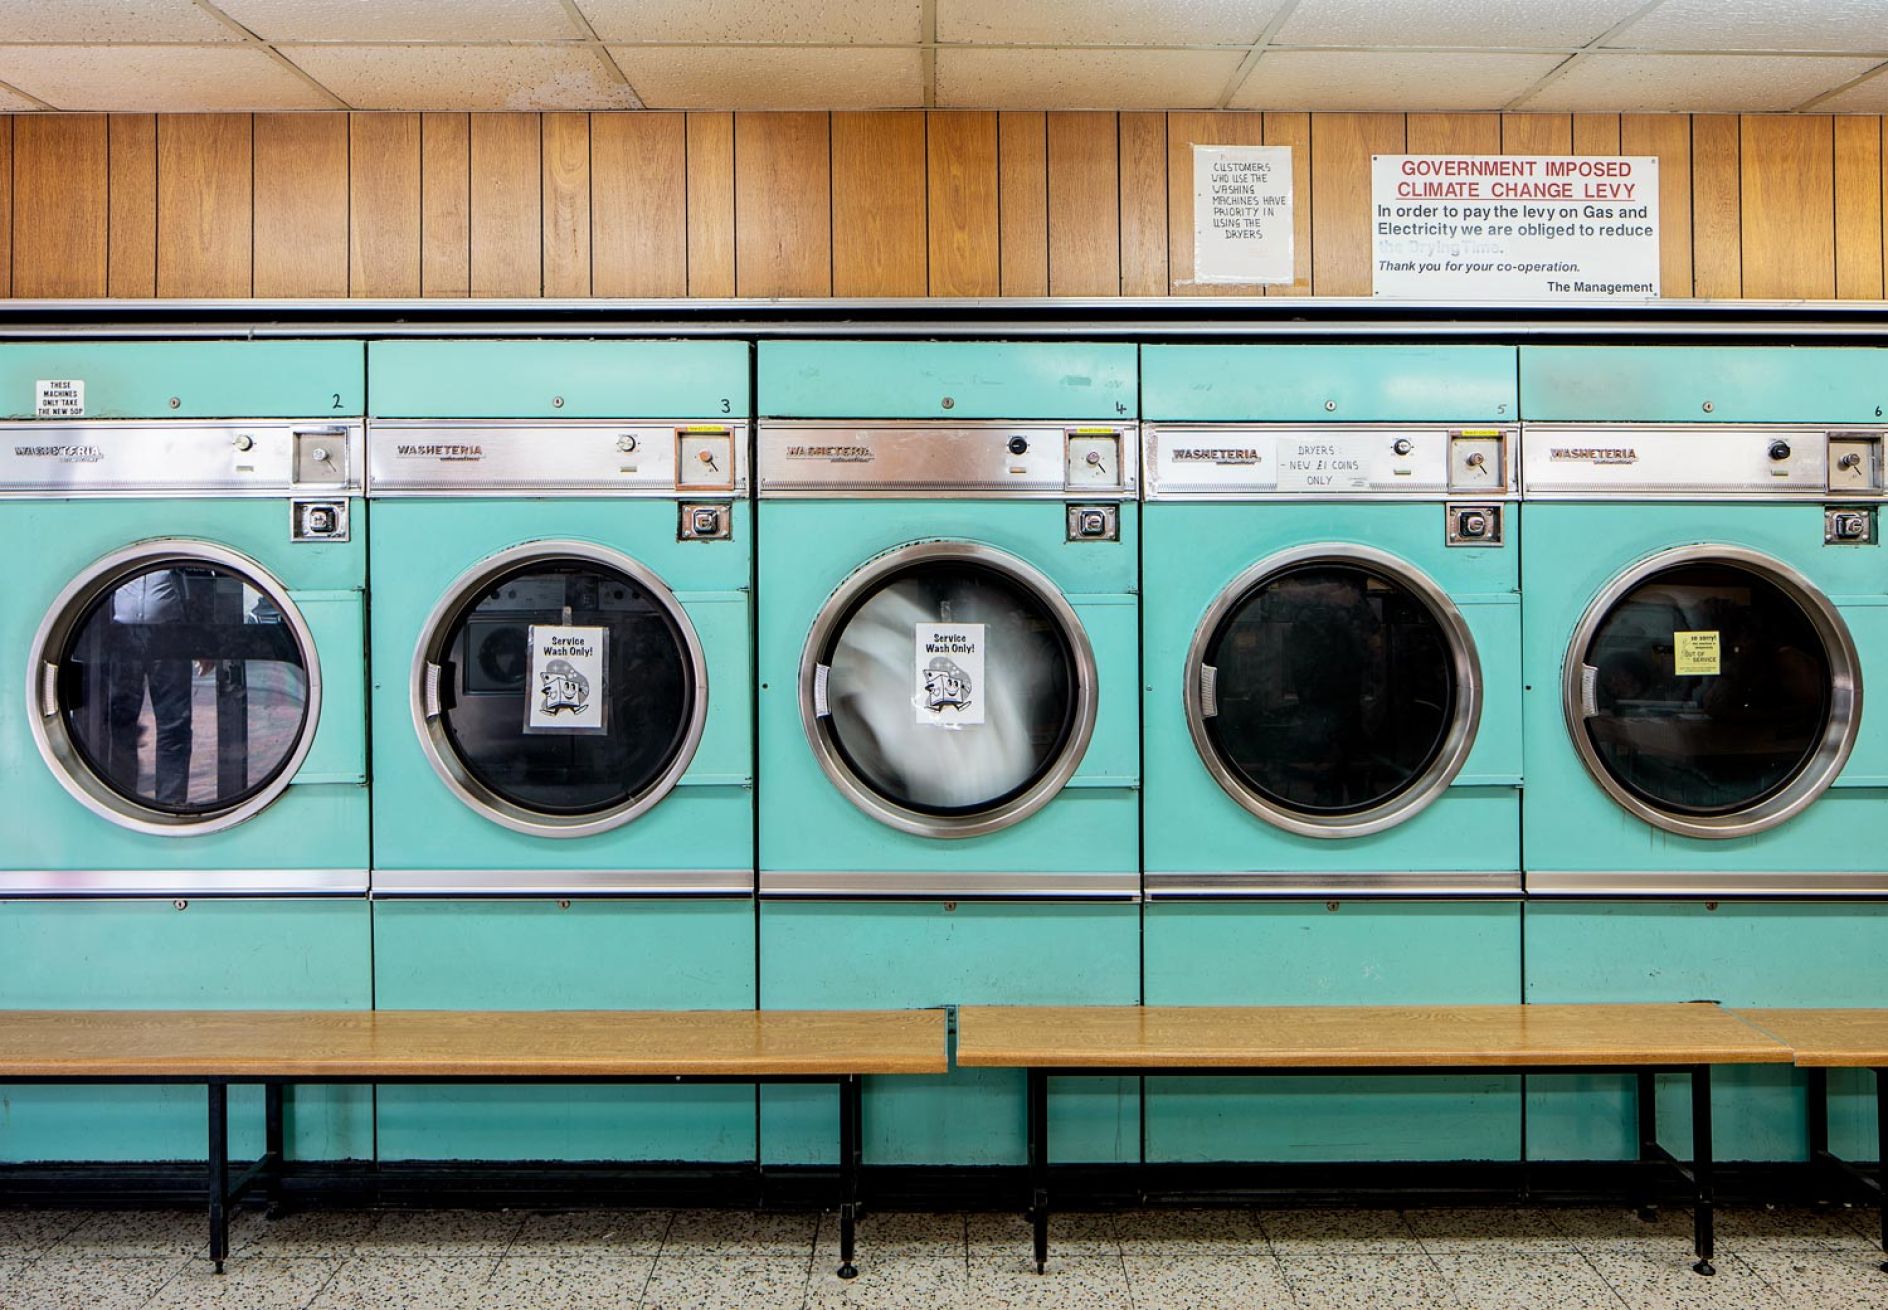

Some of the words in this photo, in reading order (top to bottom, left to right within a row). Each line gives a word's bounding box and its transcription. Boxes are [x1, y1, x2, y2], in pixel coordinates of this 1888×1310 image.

[1213, 162, 1272, 172] CUSTOMERS
[1401, 160, 1537, 177] GOVERNMENT
[1545, 161, 1631, 177] IMPOSED
[1211, 173, 1229, 183] WHO
[1232, 173, 1248, 183] USE
[1250, 173, 1268, 183] THE
[1212, 184, 1255, 195] WASHING
[1397, 181, 1480, 198] CLIMATE
[1491, 182, 1573, 198] CHANGE
[1584, 183, 1636, 199] LEVY
[1212, 196, 1260, 206] MACHINES
[1263, 196, 1286, 206] HAVE
[1213, 207, 1259, 217] PRIORITY
[1263, 207, 1275, 217] IN
[1377, 204, 1391, 218] In
[1396, 204, 1438, 219] order
[1443, 206, 1458, 219] to
[1463, 208, 1490, 221] pay
[1494, 205, 1519, 219] the
[1523, 205, 1556, 222] levy
[1559, 208, 1578, 219] on
[1583, 206, 1613, 219] Gas
[1619, 206, 1648, 219] and
[1213, 218, 1241, 228] USING
[1243, 218, 1261, 228] THE
[1225, 229, 1264, 239] DRYERS
[1378, 222, 1457, 238] Electricity
[1460, 225, 1482, 236] we
[1487, 225, 1513, 236] are
[1518, 223, 1576, 239] obliged
[1579, 224, 1594, 237] to
[1599, 223, 1654, 237] reduce
[1379, 260, 1416, 272] Thank
[1419, 263, 1441, 274] you
[1445, 260, 1464, 272] for
[1465, 263, 1494, 274] your
[1497, 261, 1581, 274] co-operation.
[1547, 281, 1571, 293] The
[1574, 281, 1654, 295] Management
[50, 381, 71, 389] THESE
[332, 393, 344, 409] 2
[720, 398, 731, 413] 3
[1115, 400, 1128, 415] 4
[1496, 403, 1507, 415] 5
[1875, 405, 1883, 418] 6
[397, 445, 483, 455] WASHETERIA
[786, 446, 873, 457] WASHETERIA
[1172, 449, 1259, 460] WASHETERIA
[1550, 449, 1636, 459] WASHETERIA
[1289, 460, 1311, 470] NEW
[1332, 460, 1359, 470] COINS
[1306, 475, 1333, 485] ONLY
[551, 636, 585, 645] Service
[934, 633, 967, 643] Service
[543, 646, 568, 656] Wash
[569, 646, 593, 657] Only!
[926, 643, 950, 653] Wash
[951, 643, 975, 654] Only!
